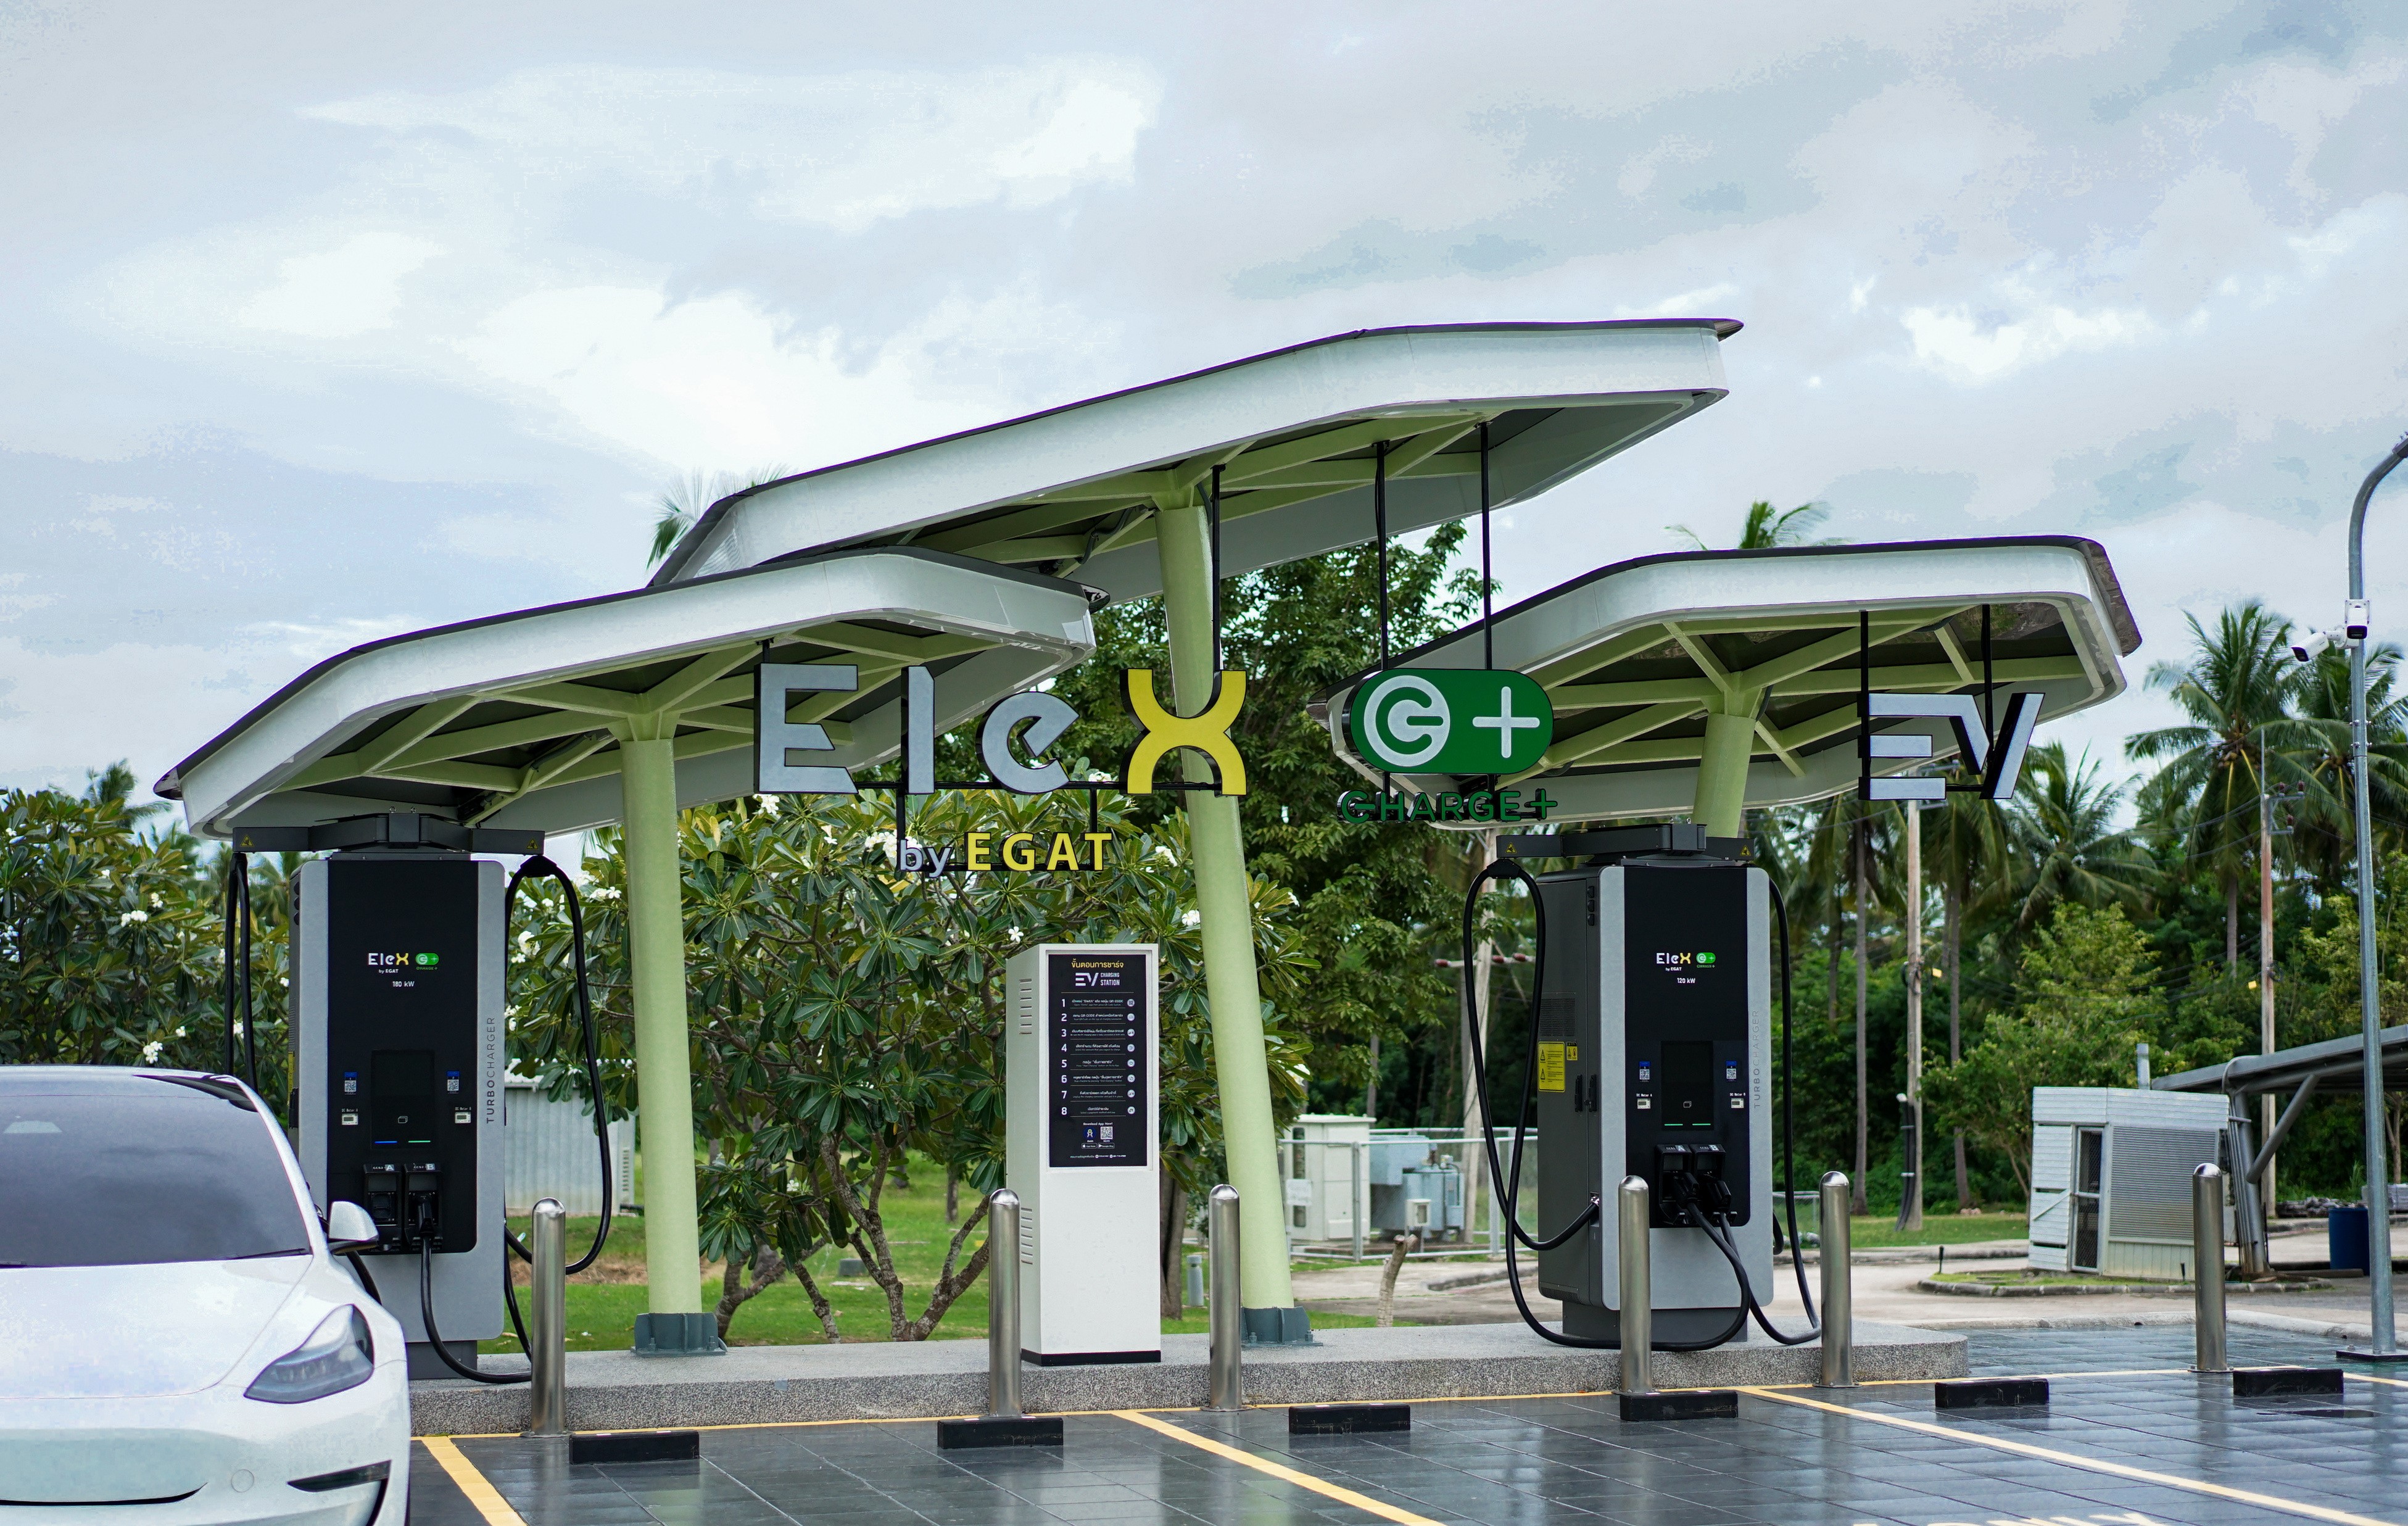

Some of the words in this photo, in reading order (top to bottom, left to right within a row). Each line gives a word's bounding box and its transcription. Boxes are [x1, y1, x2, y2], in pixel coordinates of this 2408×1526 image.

[754, 663, 1247, 795] EleX
[1858, 692, 2045, 800] EV
[898, 840, 953, 878] by
[964, 832, 1112, 871] EGAT
[368, 953, 409, 965] EleX
[1071, 958, 1124, 968] ขั้นตอนการชาร์จ
[1656, 953, 1691, 964] EleX
[1075, 972, 1099, 986] EV
[1061, 998, 1065, 1007] 1
[1061, 1013, 1067, 1021] 2
[1061, 1029, 1067, 1037] 3
[1061, 1043, 1067, 1052] 4
[1061, 1059, 1067, 1068] 5
[1752, 1010, 1760, 1109] TURBOCHARGER
[487, 1018, 495, 1124] TURBOCHARGER
[1061, 1075, 1067, 1084] 6
[1061, 1090, 1067, 1099] 7
[1061, 1106, 1067, 1115] 8
